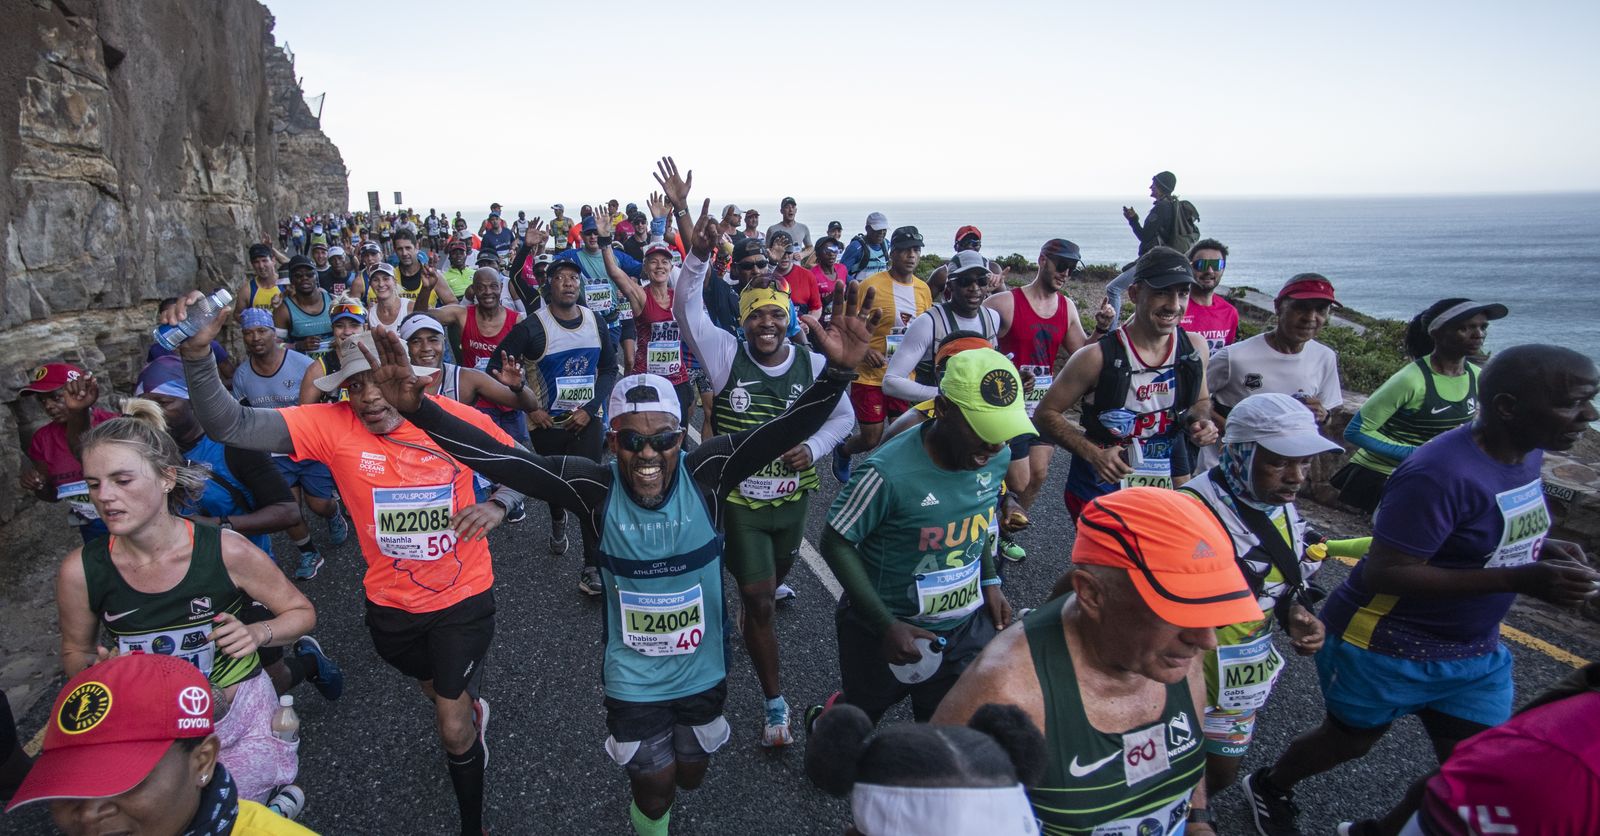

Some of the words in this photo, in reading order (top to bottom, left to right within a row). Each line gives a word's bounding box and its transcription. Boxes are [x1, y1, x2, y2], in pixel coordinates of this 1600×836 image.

[656, 351, 680, 362] 25174
[560, 389, 566, 400] K
[567, 388, 593, 401] 28020
[776, 481, 796, 494] 40
[380, 508, 450, 533] M22085
[918, 506, 995, 552] RUN
[427, 534, 453, 557] 50
[633, 566, 669, 576] ATHLETICS
[670, 564, 687, 573] CLUB
[638, 595, 685, 606] TOTALSPORTS
[631, 613, 640, 631] L
[643, 605, 701, 633] 24004
[183, 632, 205, 645] ASA
[676, 628, 703, 650] 40
[1224, 689, 1246, 697] Gabs
[178, 719, 210, 730] TOYOTA
[1127, 738, 1157, 767] 60
[1168, 738, 1198, 759] NEDBANK
